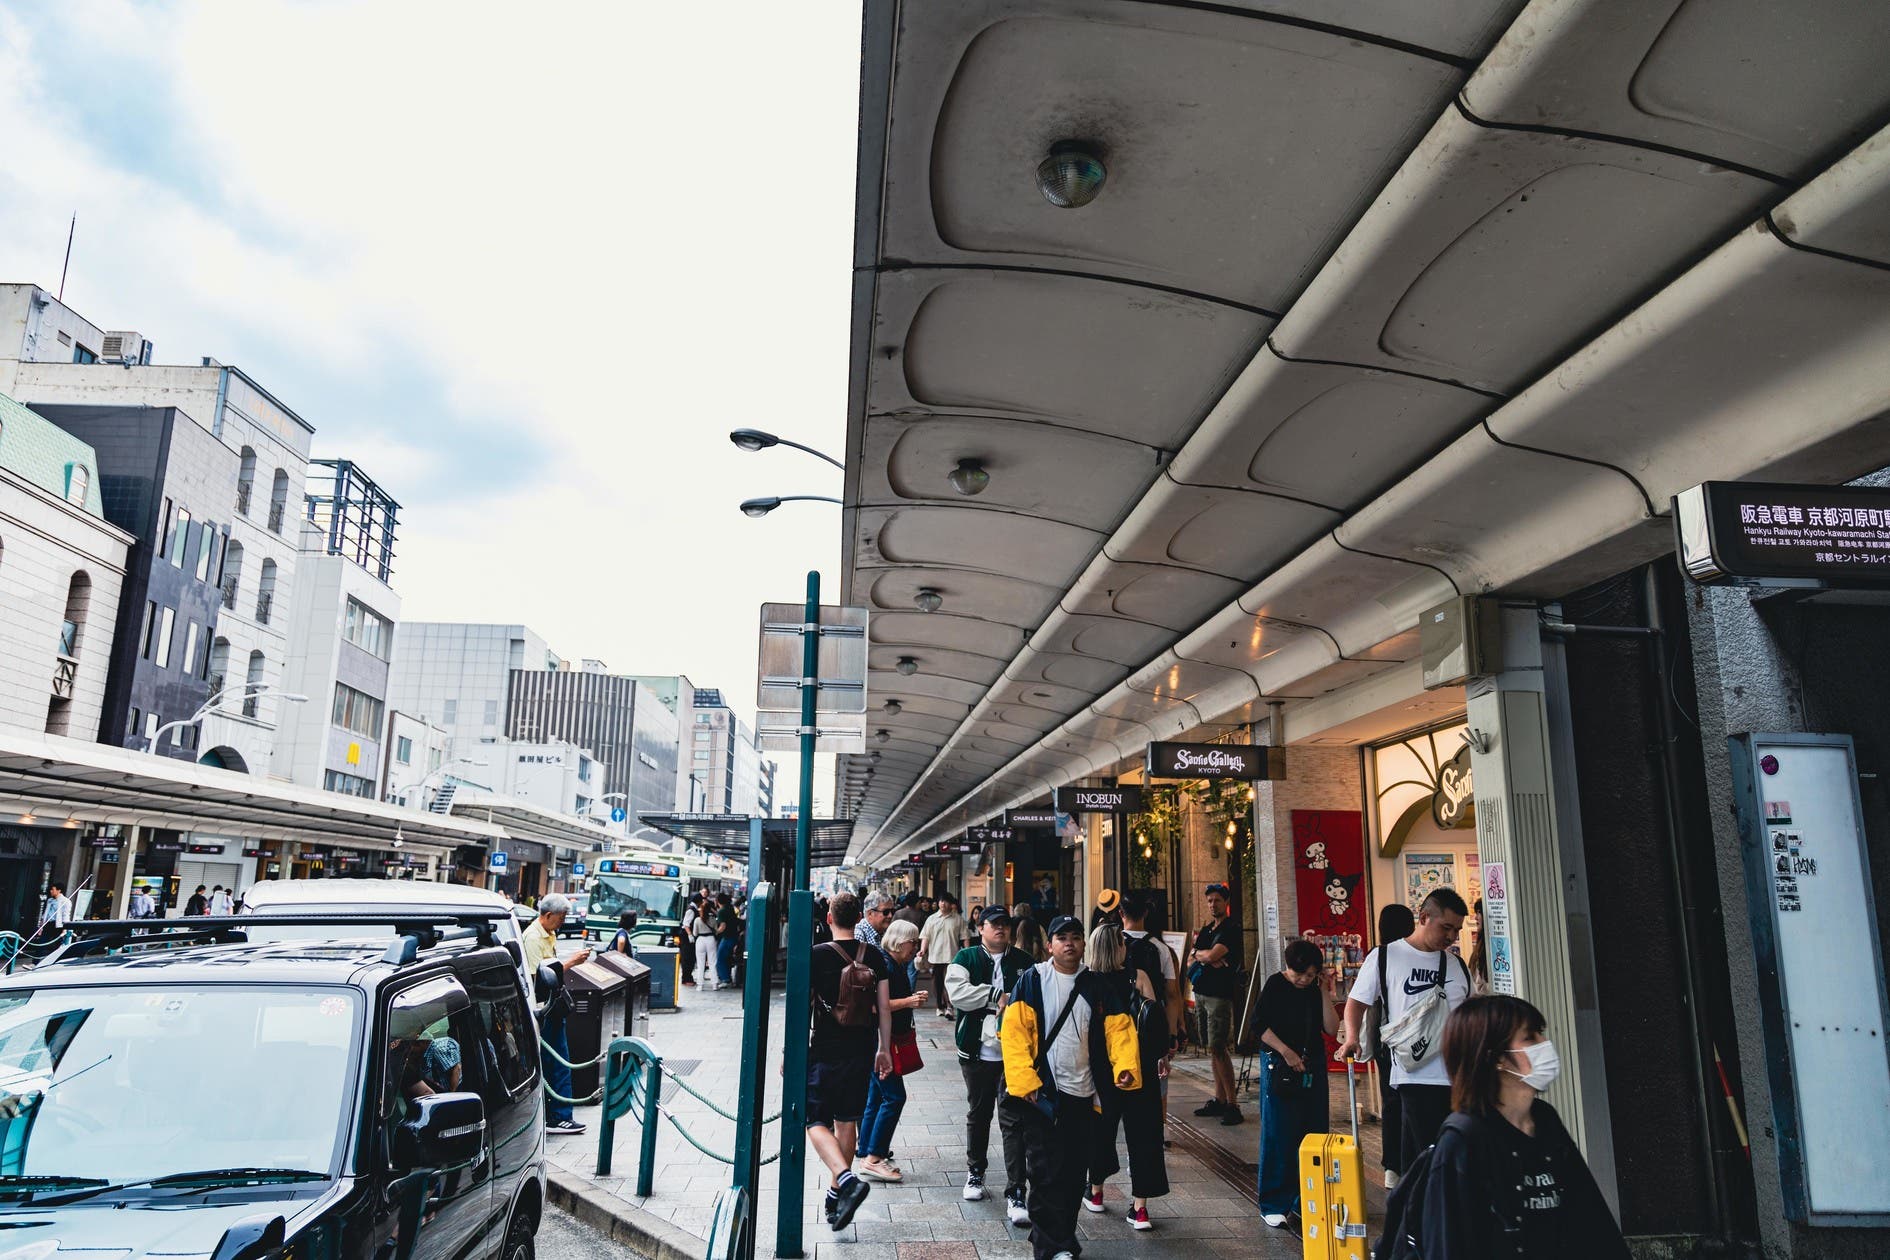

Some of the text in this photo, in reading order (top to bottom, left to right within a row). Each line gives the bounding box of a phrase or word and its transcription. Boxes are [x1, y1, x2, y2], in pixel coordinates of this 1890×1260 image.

[1741, 504, 1804, 525] 阪急電車
[1744, 526, 1772, 536] Hankyu
[1773, 527, 1802, 538] Railway
[1803, 528, 1875, 539] Kyoto-kawaramachi
[1208, 750, 1245, 772] Gallery
[1076, 793, 1122, 804] INOBUN
[1411, 1036, 1427, 1055] NIKE
